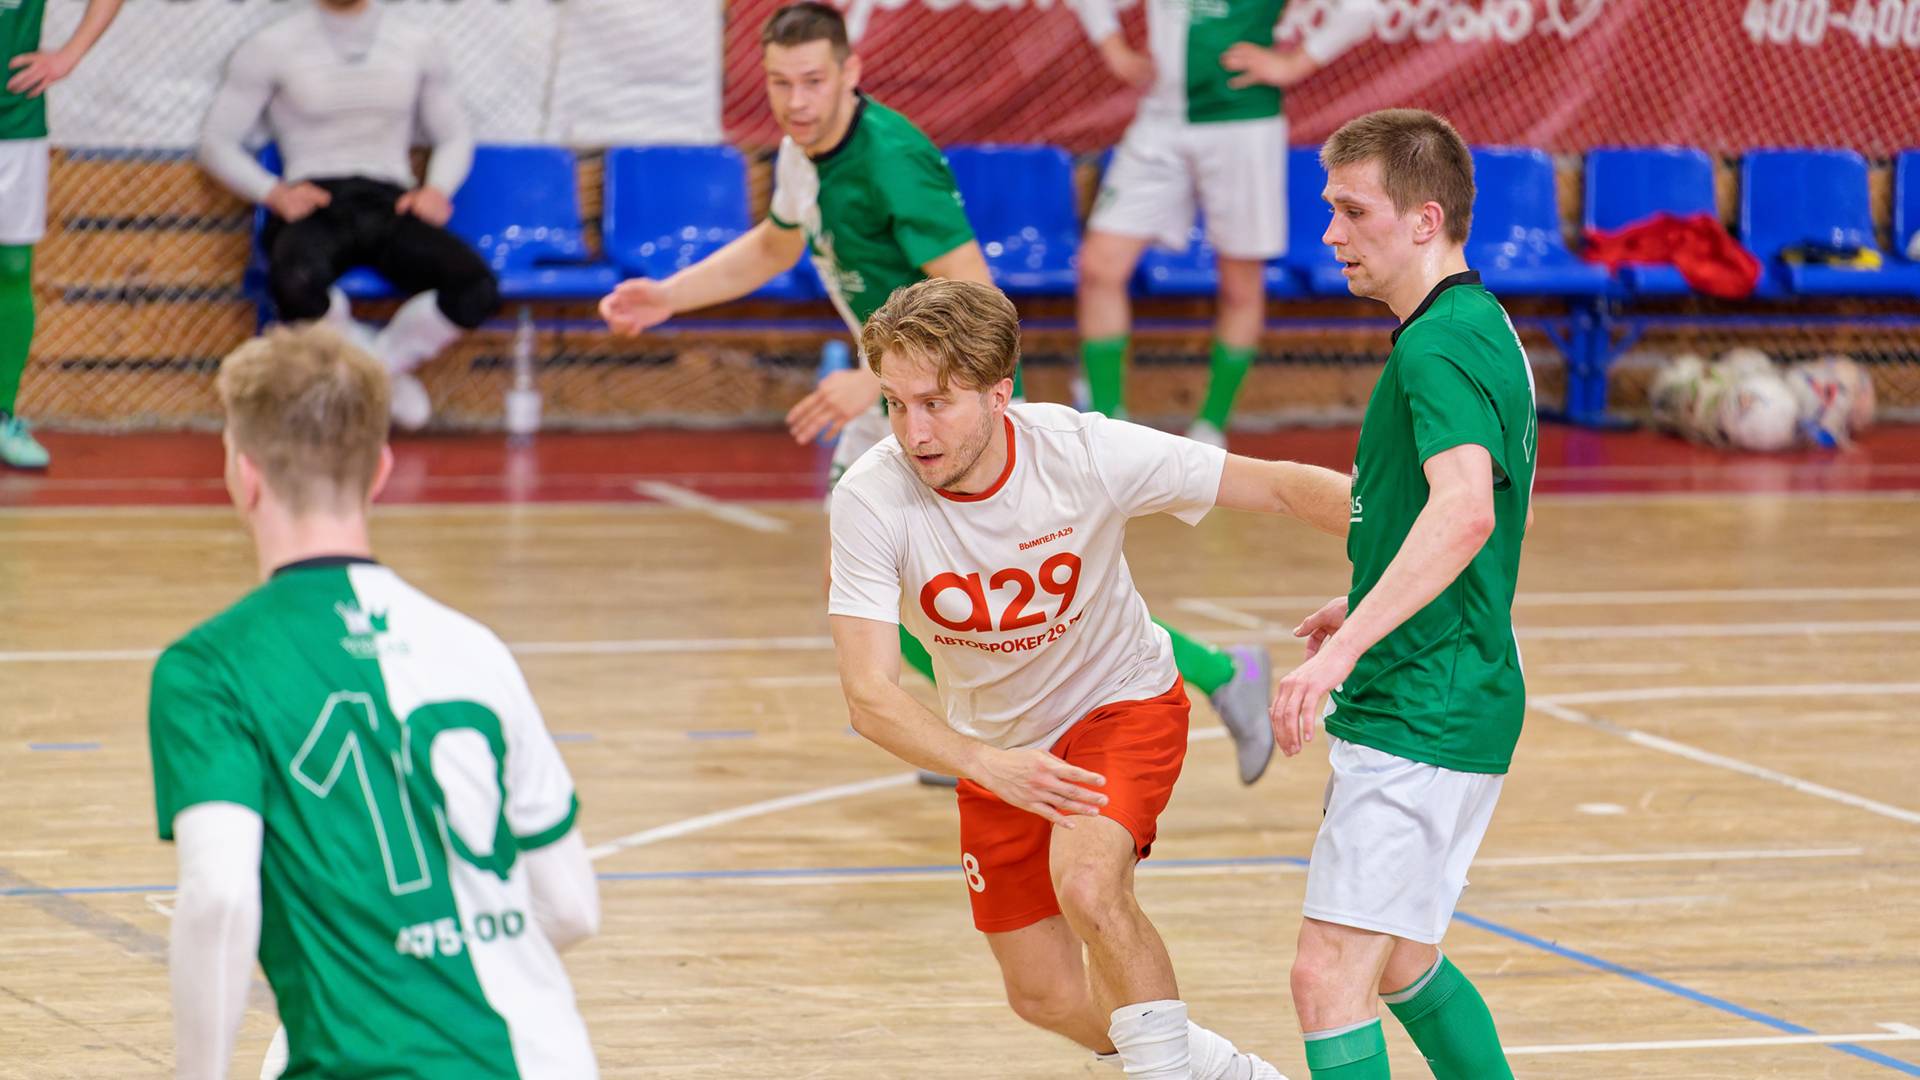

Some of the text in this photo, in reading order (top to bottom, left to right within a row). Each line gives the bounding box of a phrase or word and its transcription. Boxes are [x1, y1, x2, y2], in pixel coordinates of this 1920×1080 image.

[1018, 526, 1074, 551] ВЫМПЕЛ-А29
[933, 608, 1084, 654] АВТОБРОКЕР29
[289, 689, 514, 896] 10
[962, 852, 986, 893] 8
